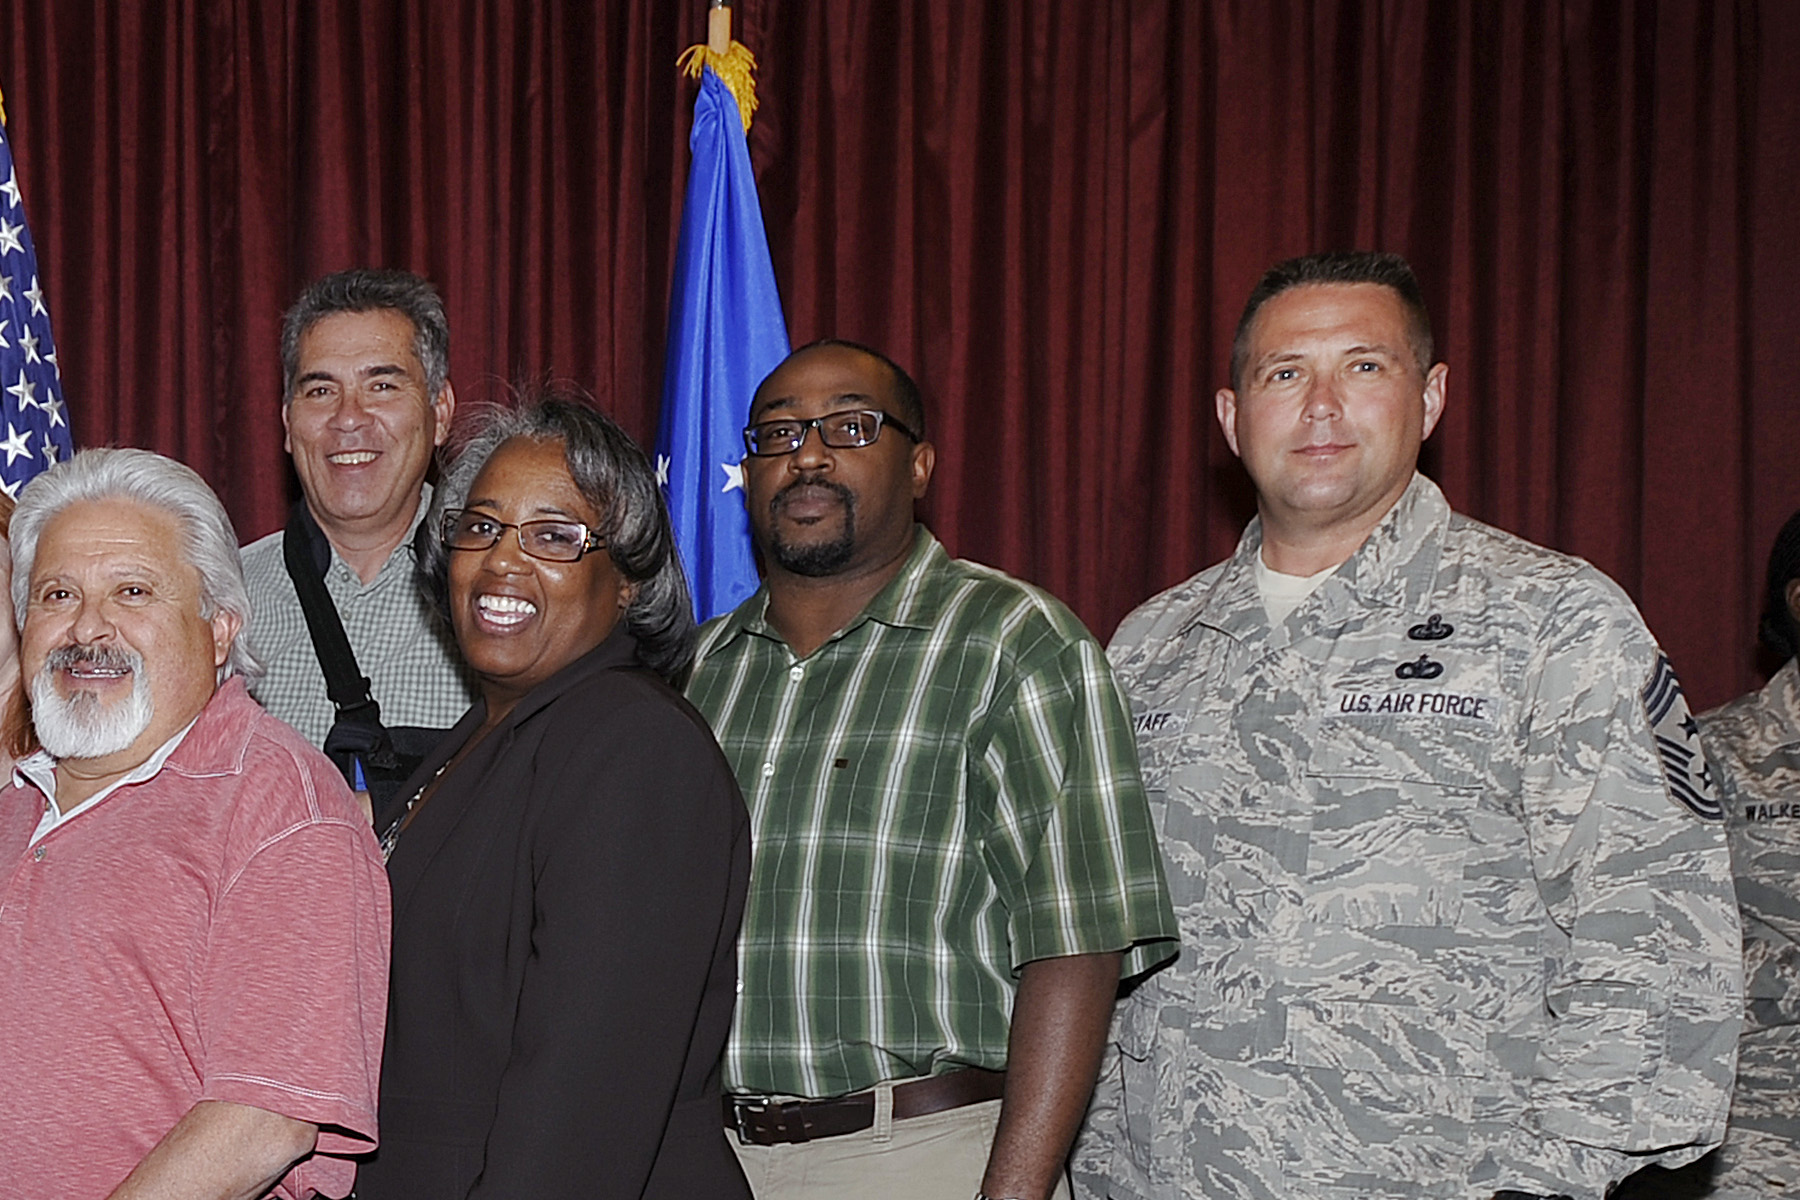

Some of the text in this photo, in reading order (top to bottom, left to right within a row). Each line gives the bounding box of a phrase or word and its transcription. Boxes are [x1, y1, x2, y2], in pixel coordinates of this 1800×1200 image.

[1340, 693, 1489, 719] U.S. AIR FORCE
[1133, 712, 1172, 733] TAFF
